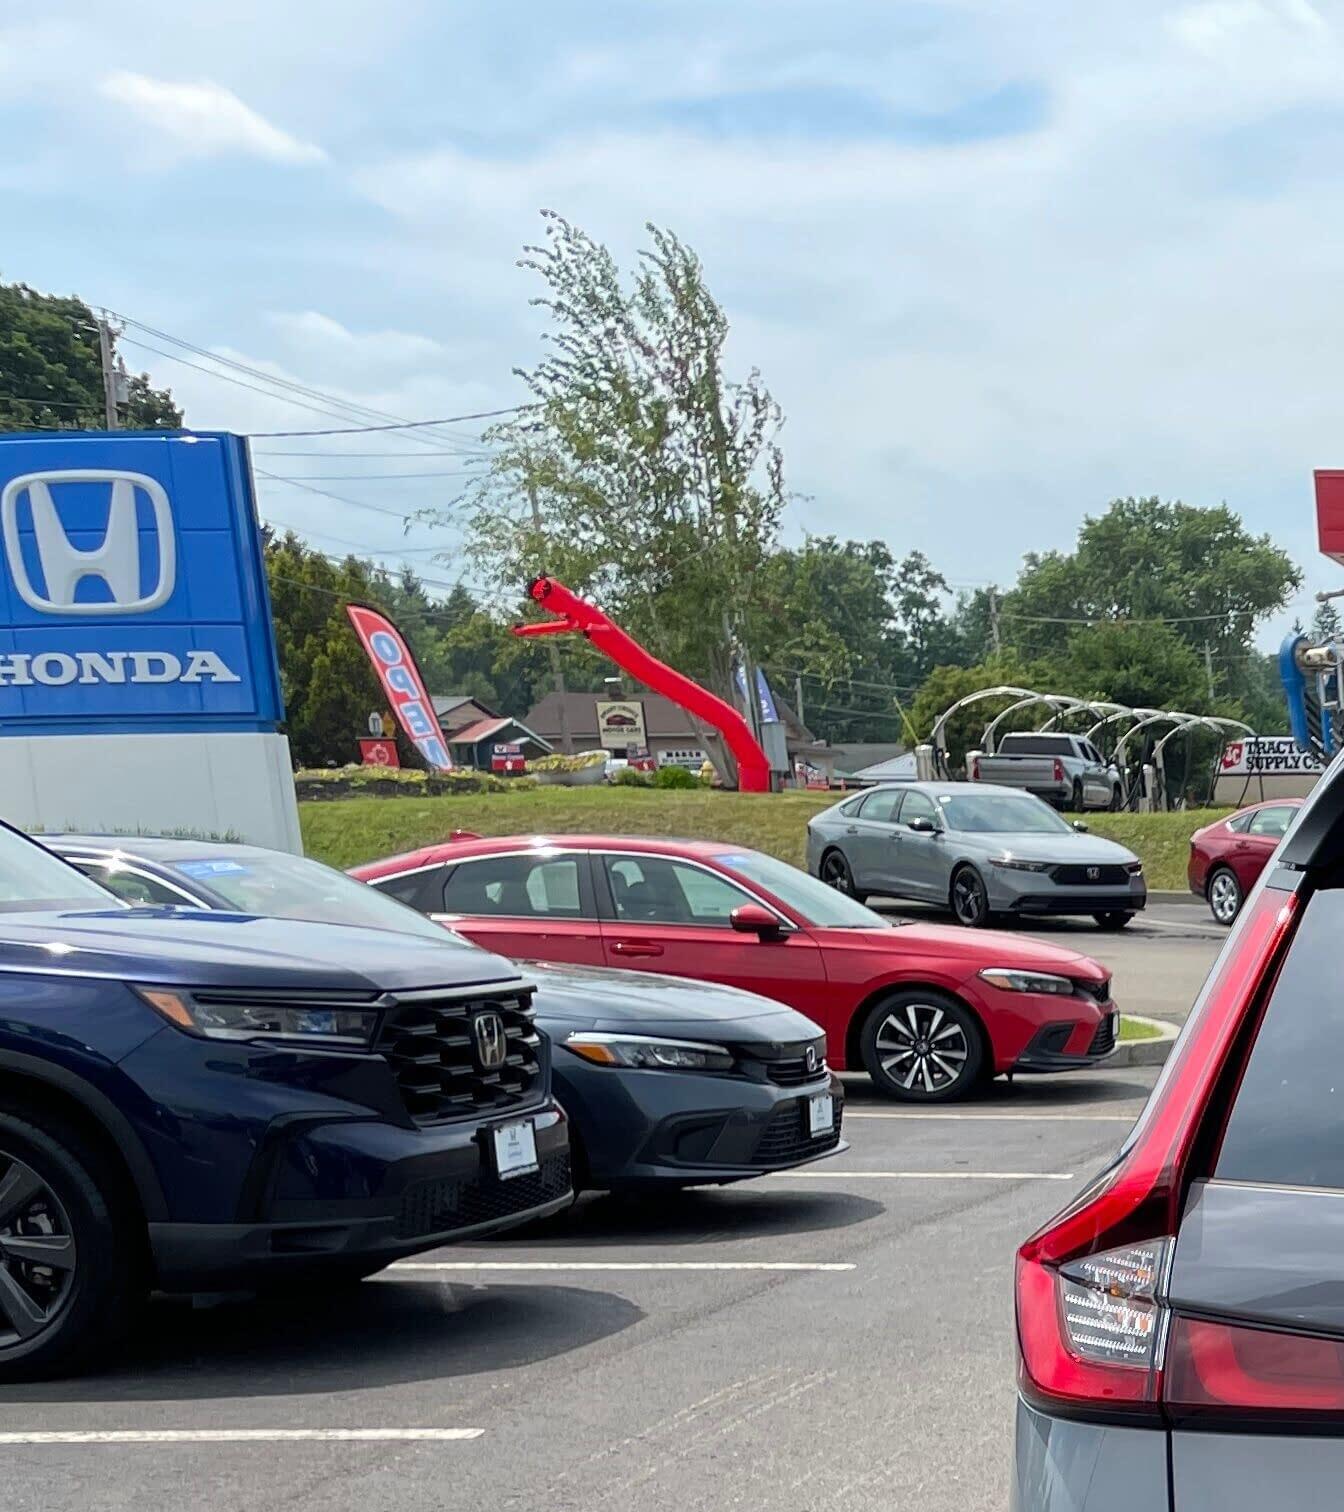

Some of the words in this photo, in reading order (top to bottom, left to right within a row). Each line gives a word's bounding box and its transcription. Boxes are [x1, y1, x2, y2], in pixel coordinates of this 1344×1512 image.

[0, 651, 241, 686] HONDA
[1246, 741, 1310, 754] TRACT
[1246, 755, 1300, 770] SUPPLY
